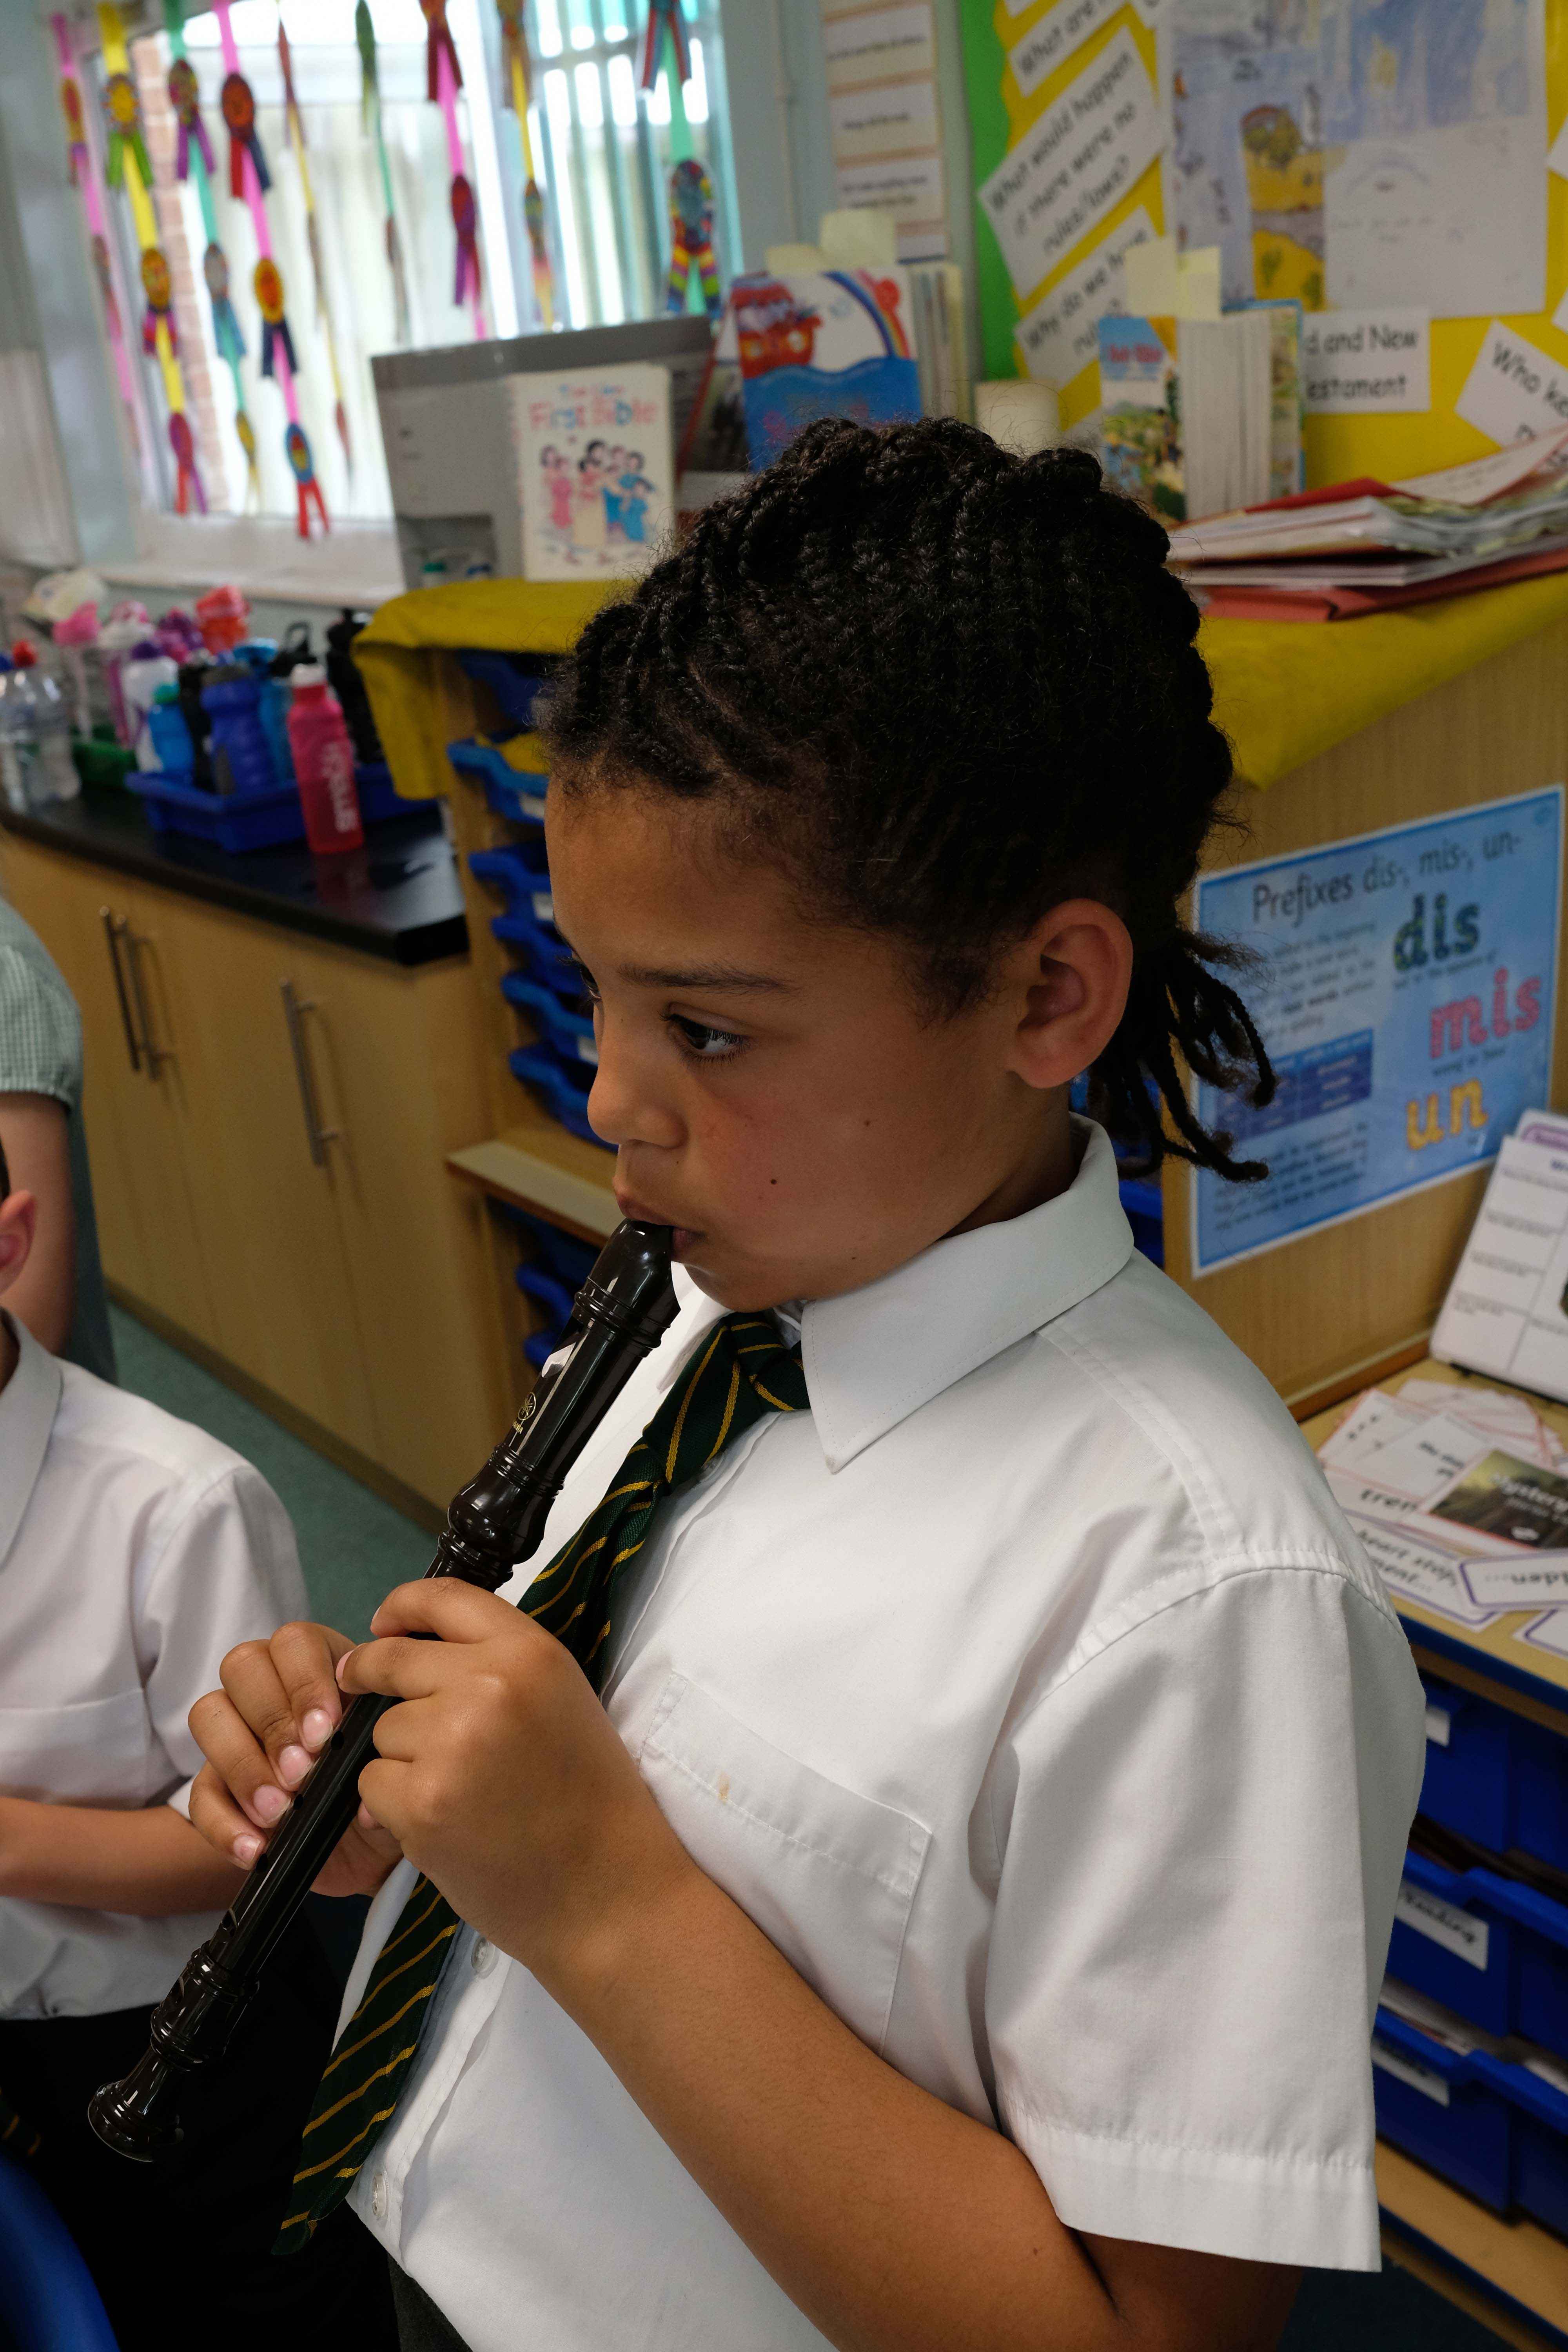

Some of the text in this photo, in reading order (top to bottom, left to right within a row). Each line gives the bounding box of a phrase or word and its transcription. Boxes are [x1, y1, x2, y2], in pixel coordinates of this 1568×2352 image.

[1323, 327, 1363, 354] and
[1368, 323, 1419, 350] New
[1306, 374, 1407, 401] estament
[1492, 341, 1542, 394] Who
[1252, 872, 1353, 929] Prefixes
[1393, 893, 1481, 973] dis
[1429, 965, 1541, 1059] mis
[1406, 1076, 1489, 1151] un
